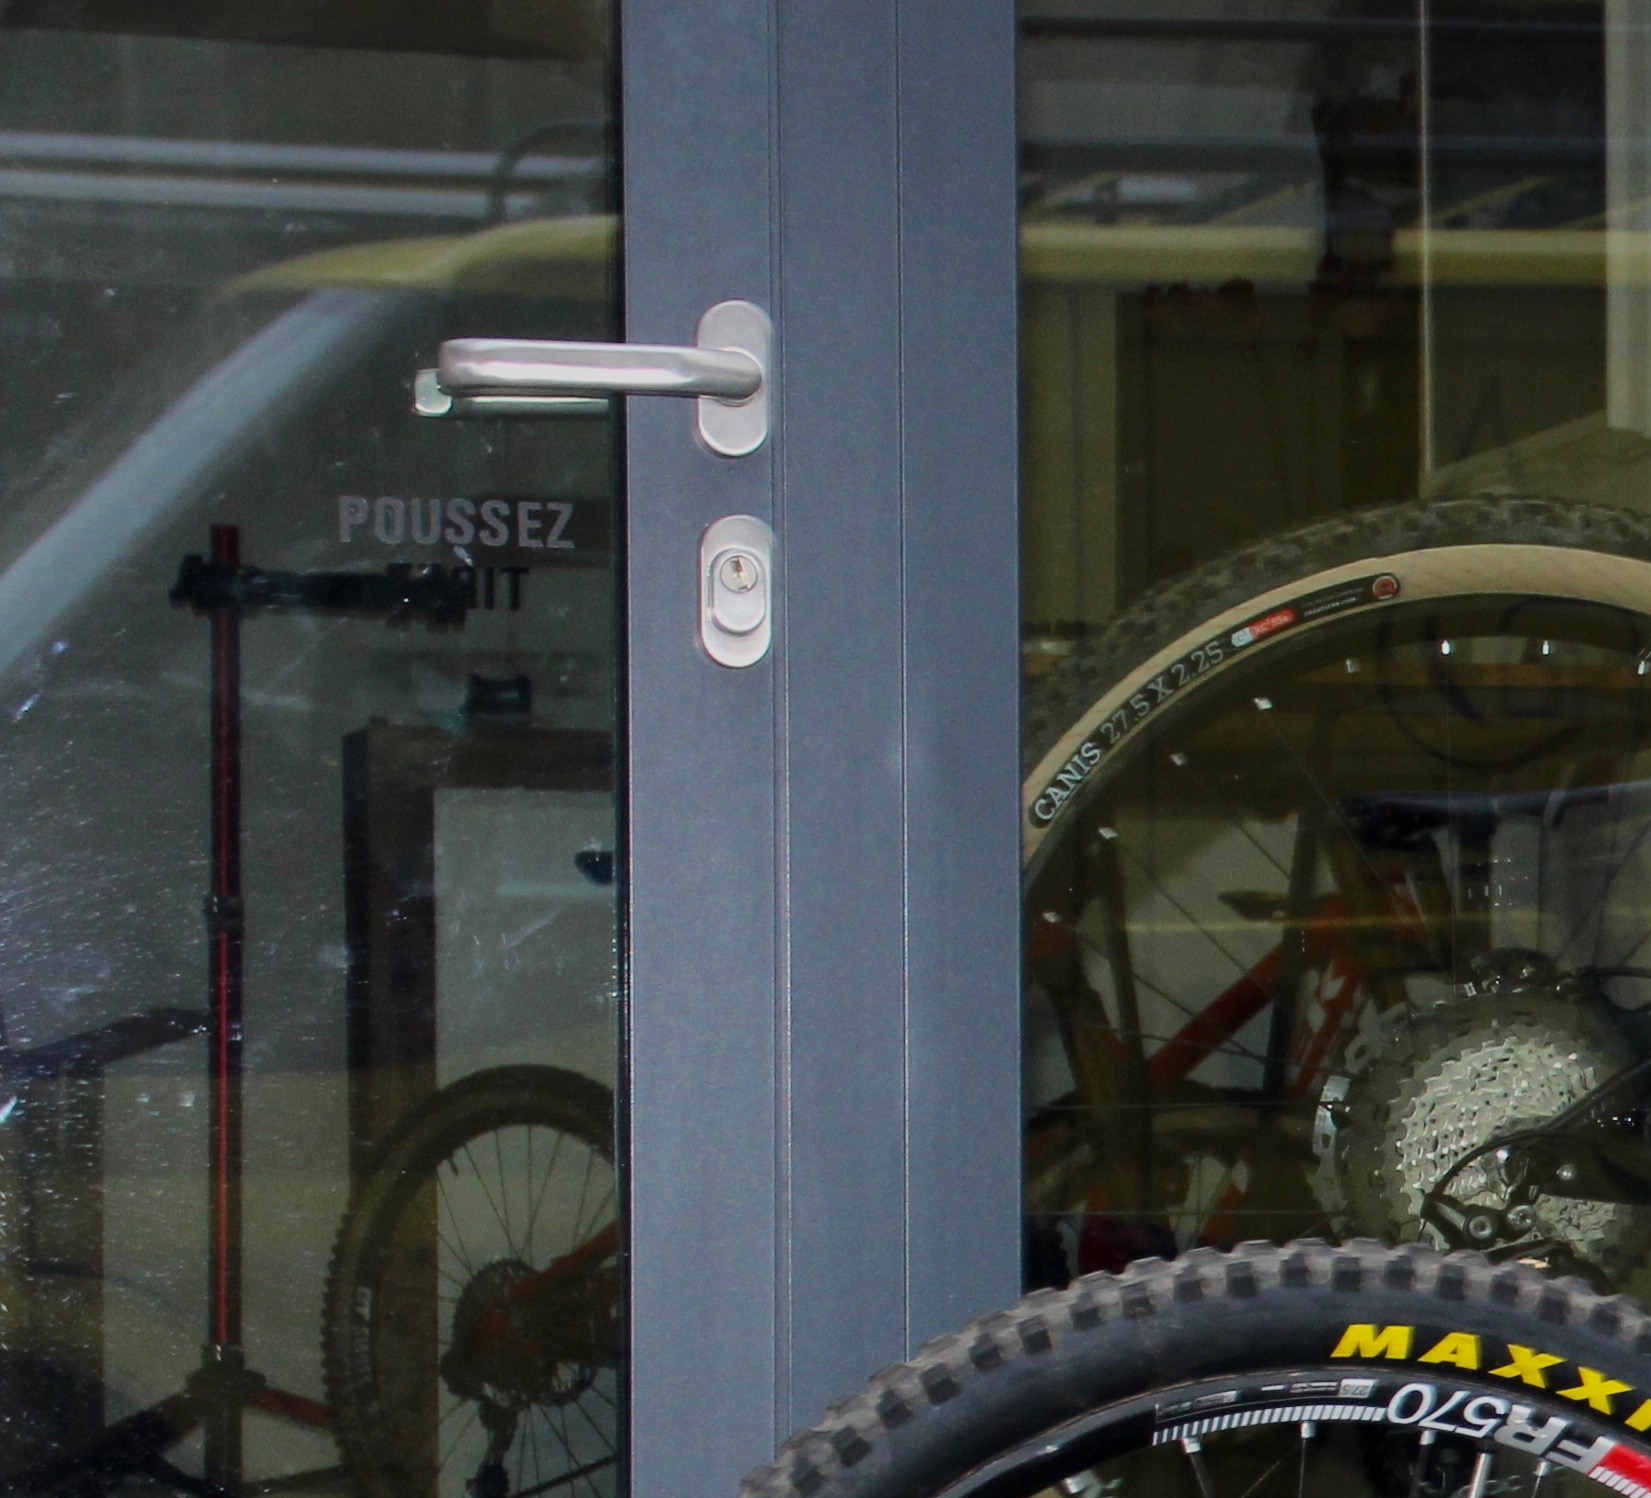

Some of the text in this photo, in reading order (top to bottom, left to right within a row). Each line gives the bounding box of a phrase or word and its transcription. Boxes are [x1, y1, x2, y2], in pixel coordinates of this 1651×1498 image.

[336, 494, 576, 550] POUSSEZ
[1032, 740, 1102, 822] CANIS
[1100, 691, 1151, 744] 27.5
[1170, 640, 1225, 688] 2.25
[1385, 1382, 1619, 1478] FR570
